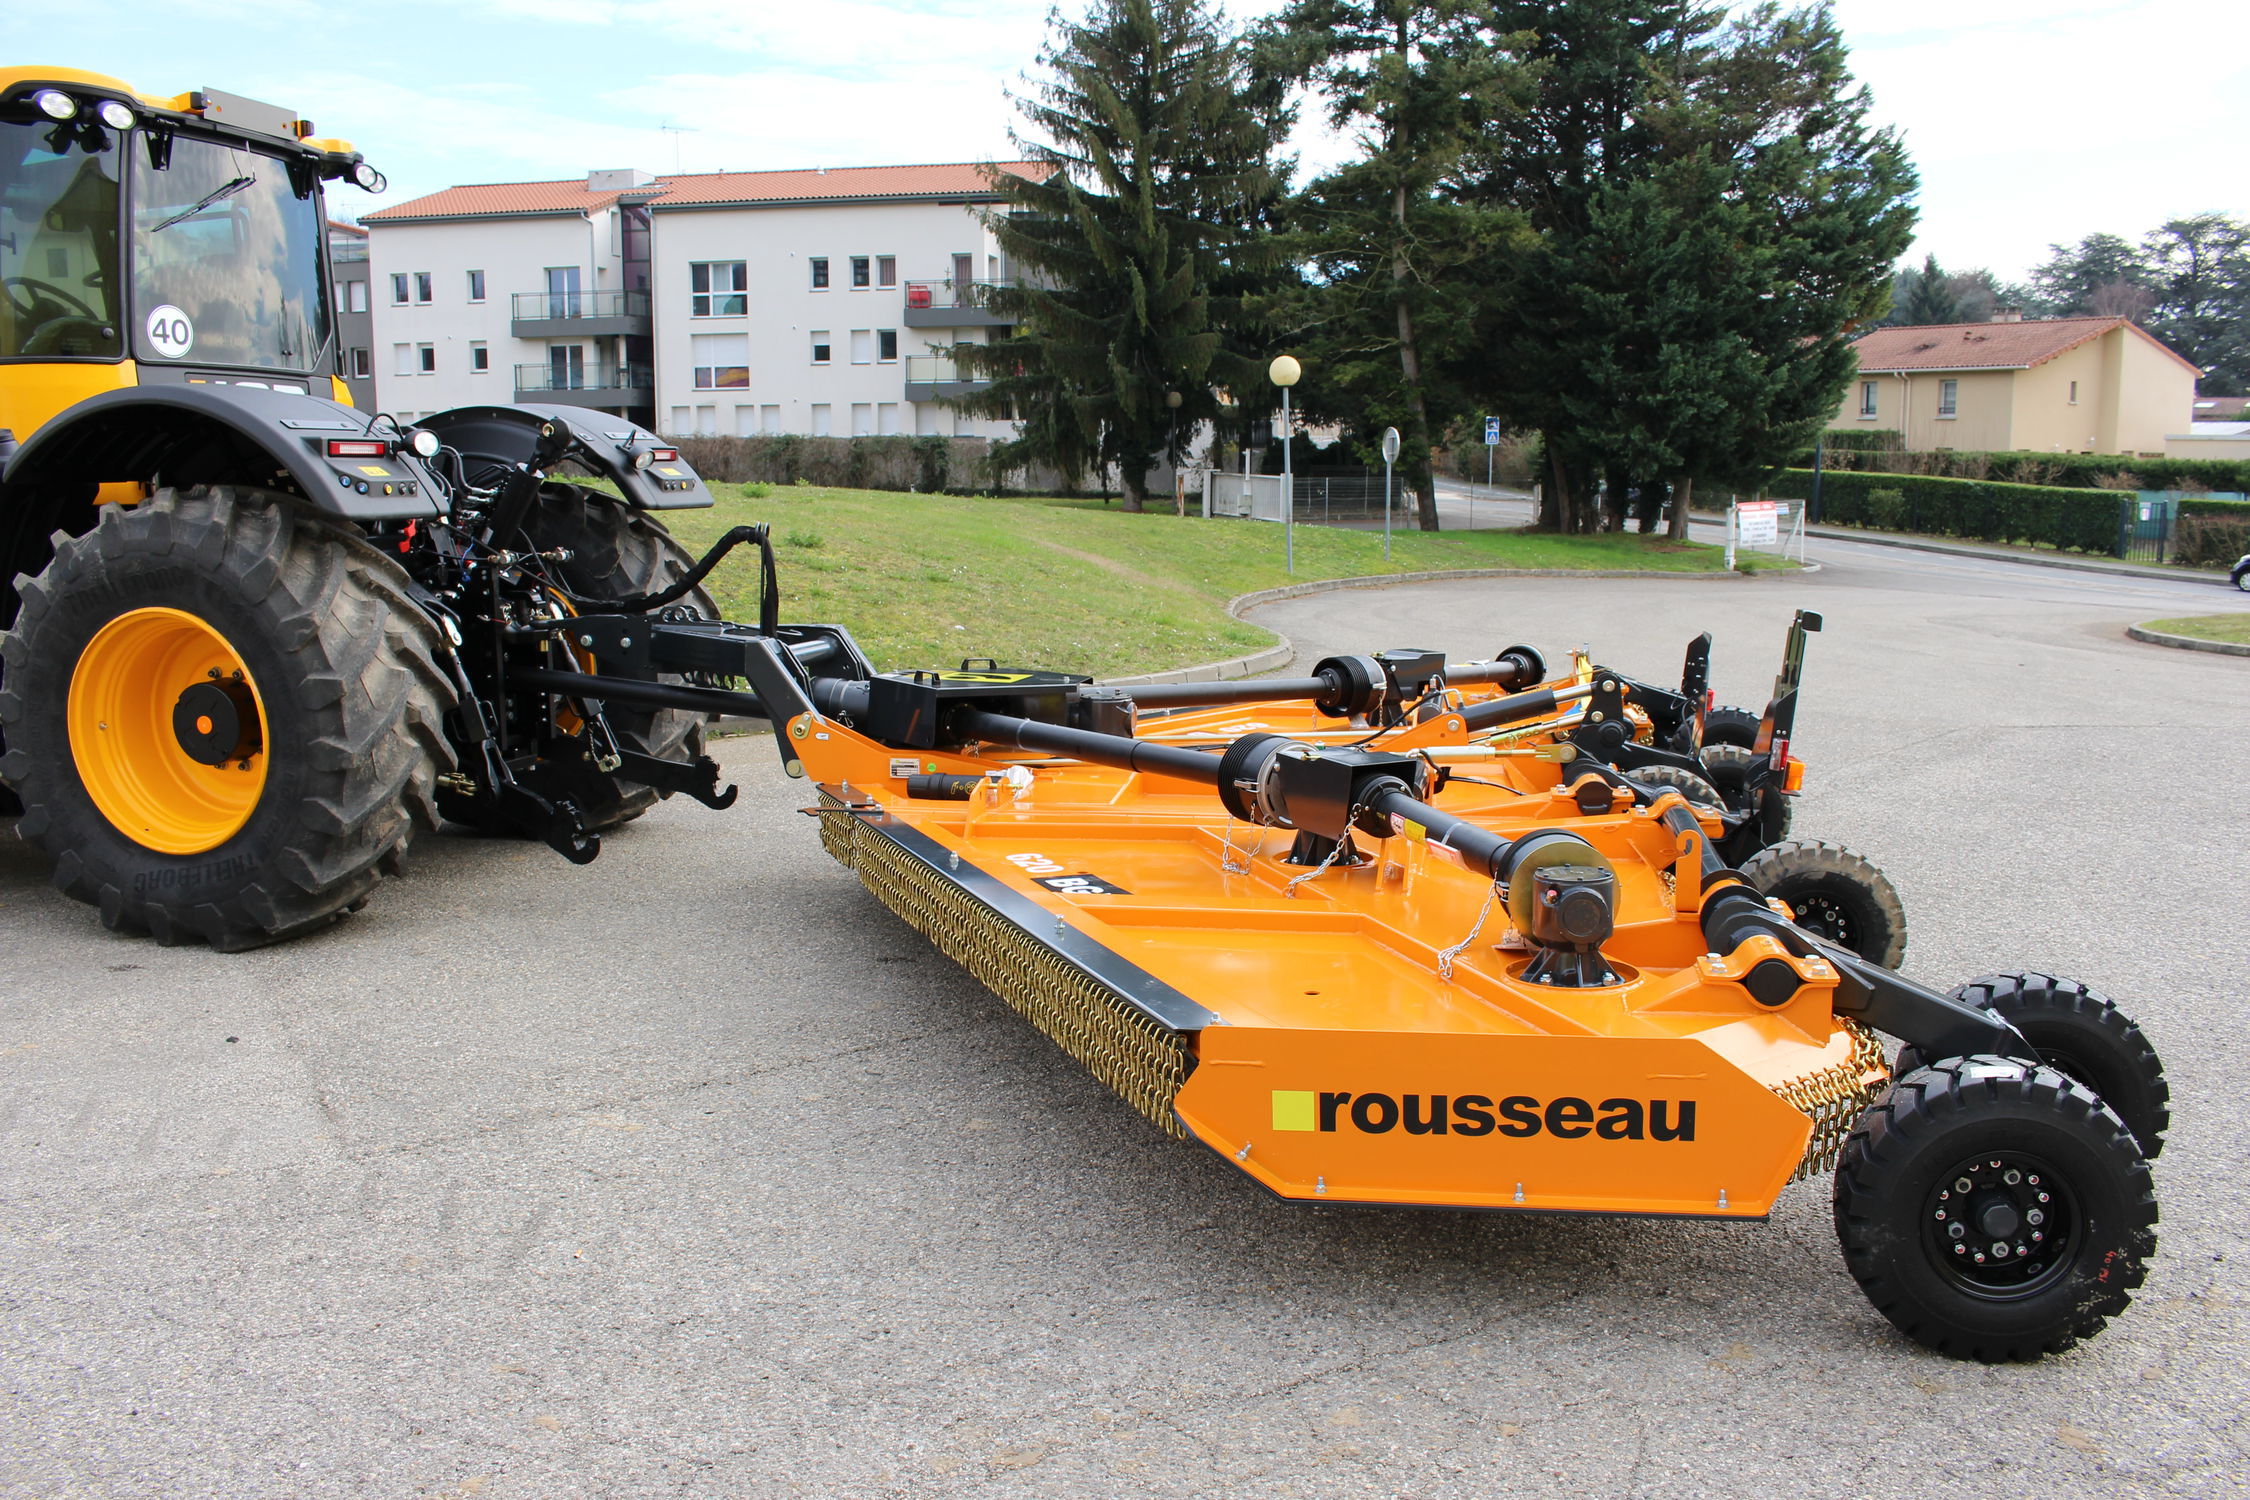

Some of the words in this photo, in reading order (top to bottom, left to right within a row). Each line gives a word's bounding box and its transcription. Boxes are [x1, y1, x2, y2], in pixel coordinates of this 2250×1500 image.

[152, 318, 190, 345] 40
[134, 852, 259, 893] TRELLEBORG
[1005, 853, 1064, 873] 620
[1044, 877, 1112, 895] BG
[1319, 1092, 1697, 1142] rousseau
